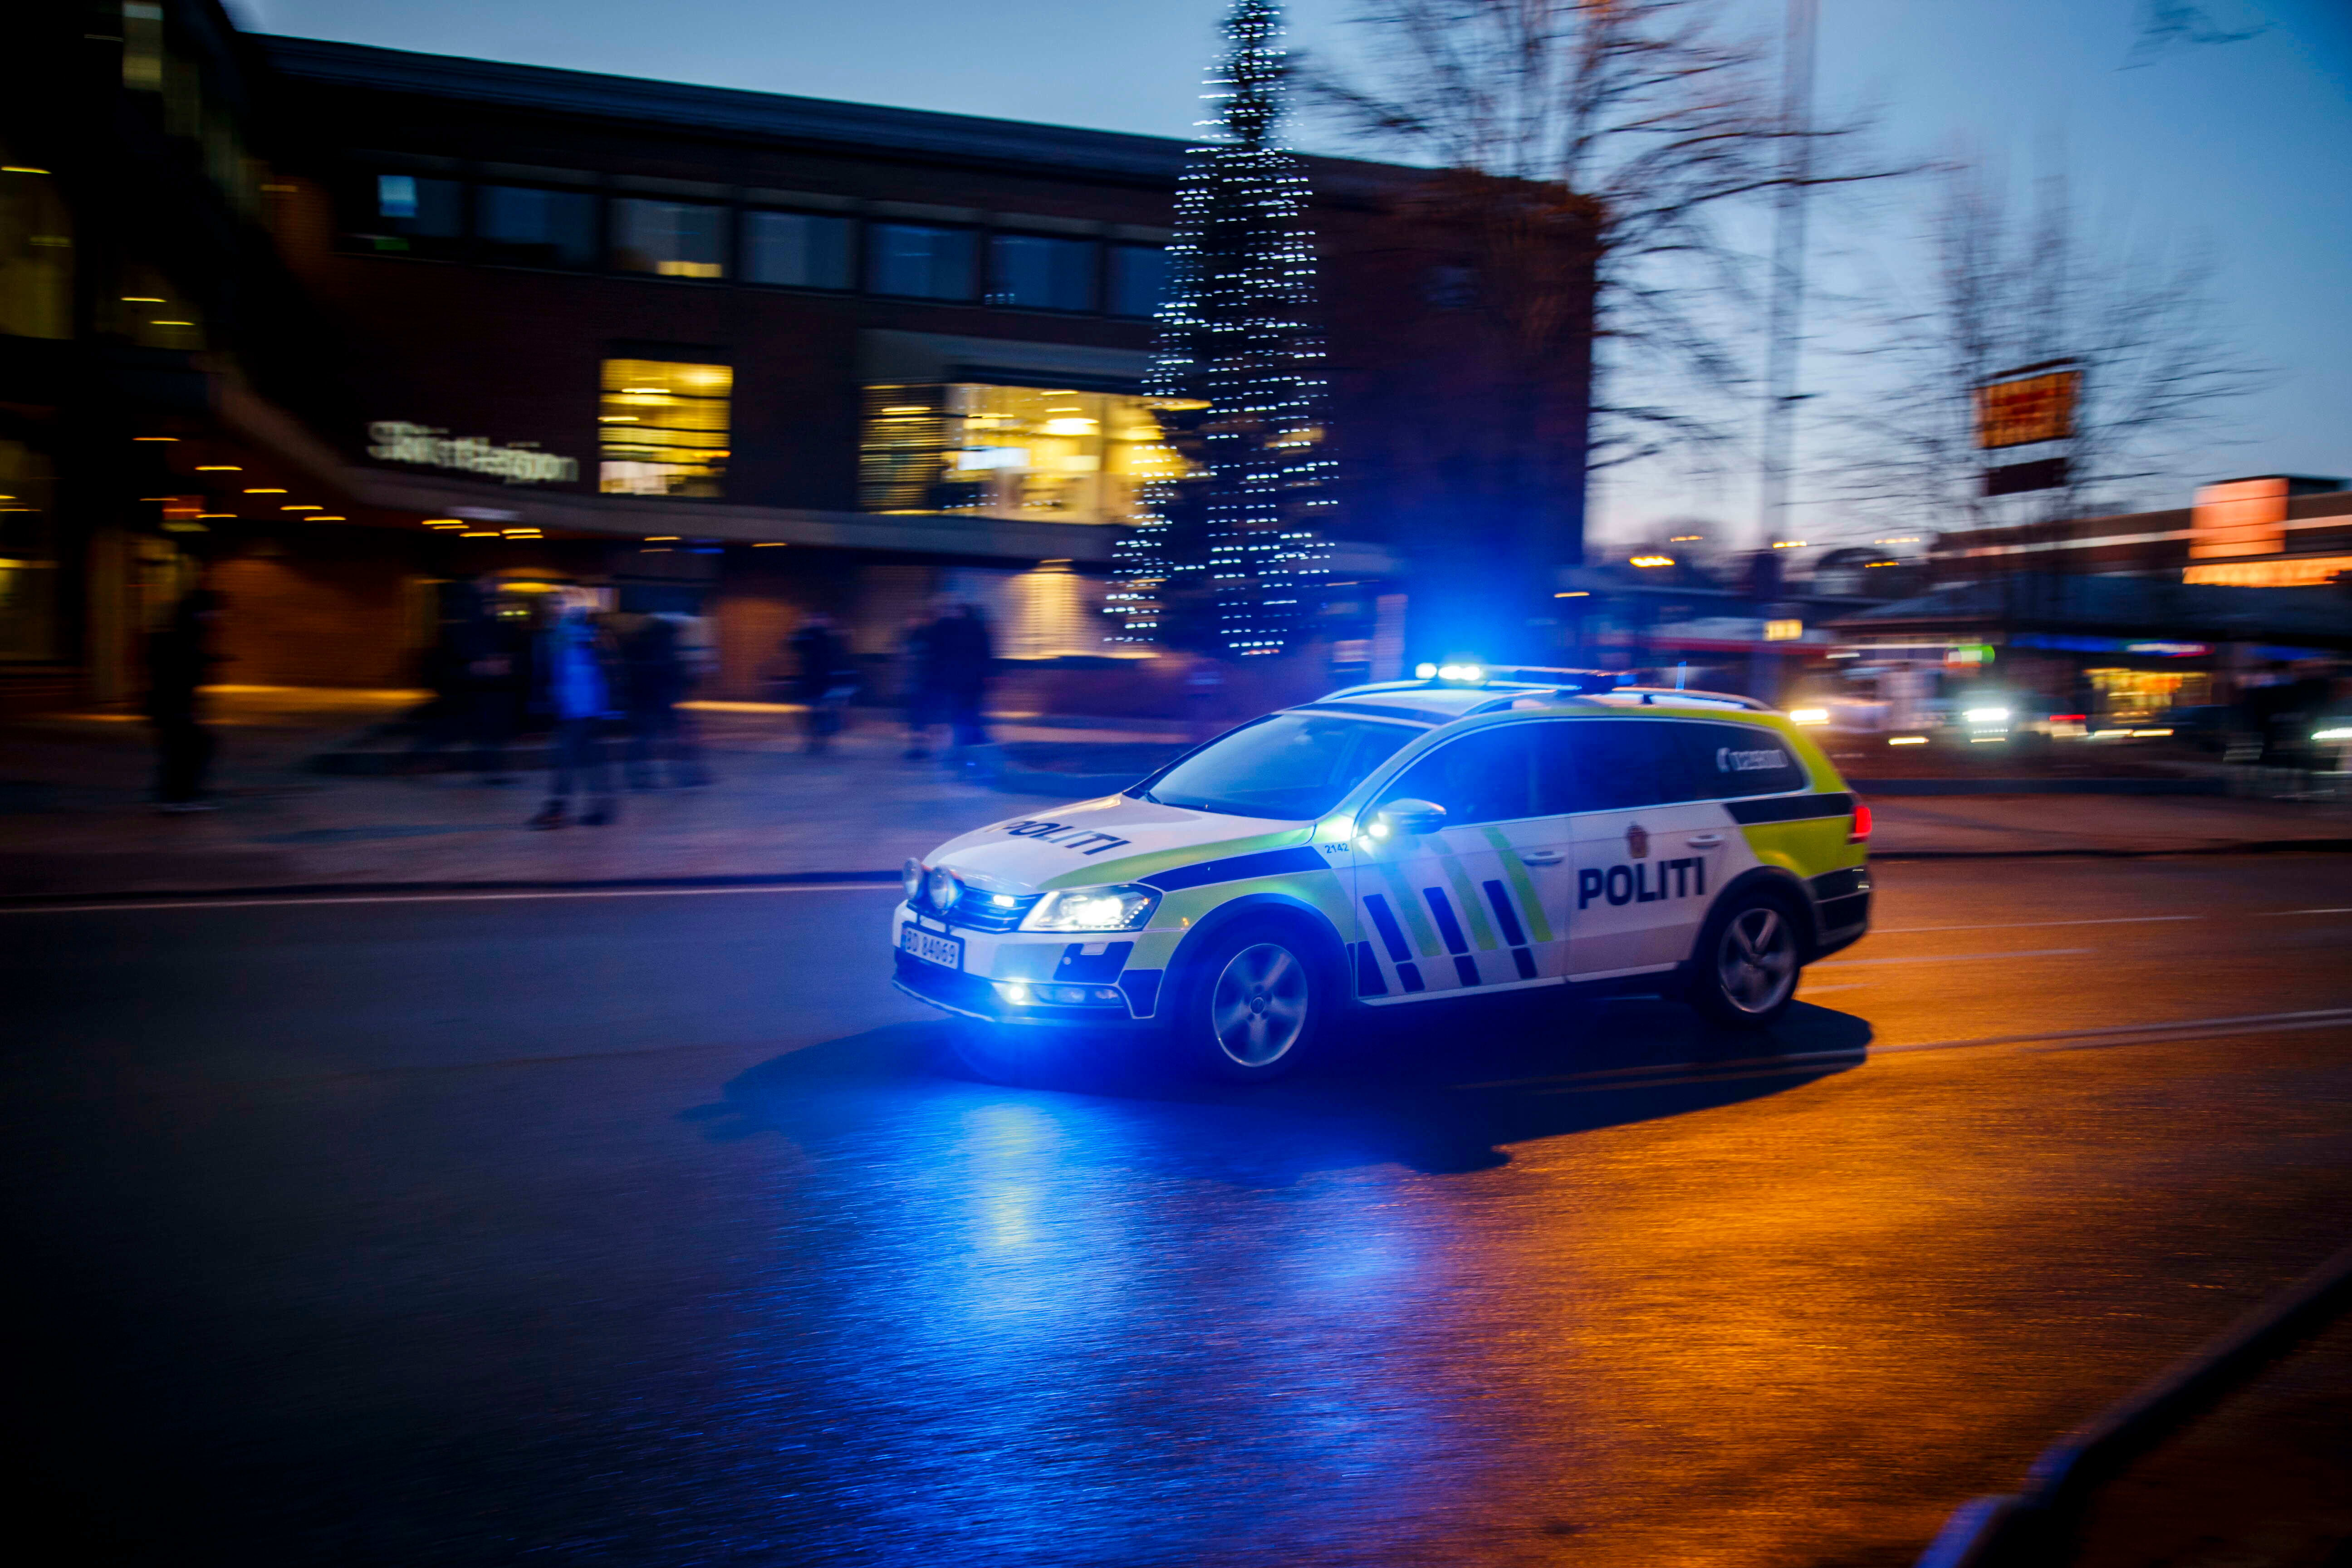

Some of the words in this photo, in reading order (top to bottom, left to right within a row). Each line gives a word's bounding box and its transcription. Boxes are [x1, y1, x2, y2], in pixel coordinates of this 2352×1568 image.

[1003, 821, 1132, 855] POLITI
[1325, 843, 1350, 853] 2142
[1578, 857, 1705, 909] POLITI
